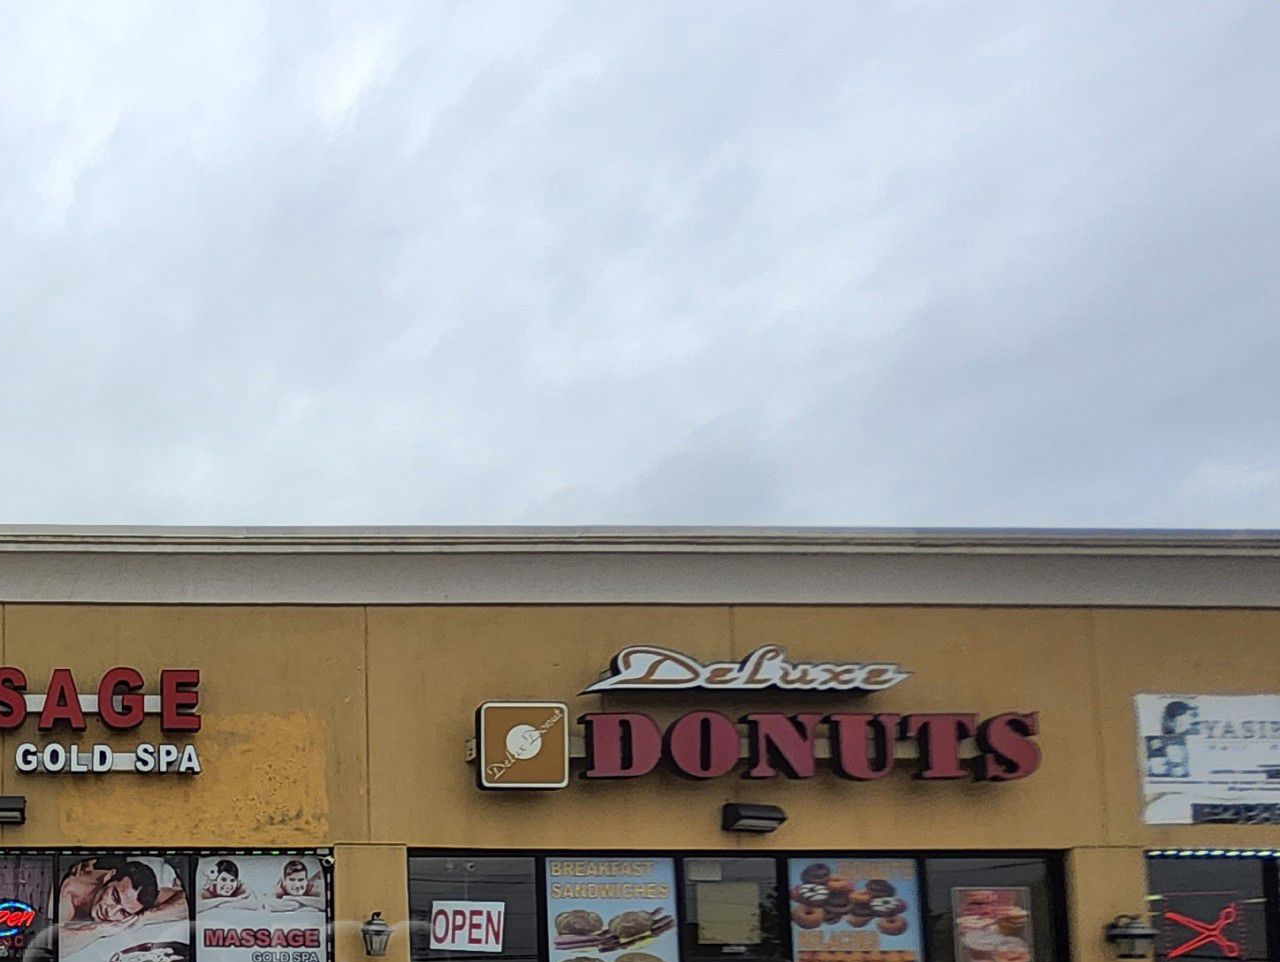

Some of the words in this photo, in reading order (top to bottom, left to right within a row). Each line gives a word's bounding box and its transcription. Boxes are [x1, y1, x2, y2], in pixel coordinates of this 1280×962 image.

[15, 743, 114, 773] GOLD
[134, 743, 202, 773] SPA
[580, 710, 1041, 782] DONUTS
[550, 861, 655, 877] BREAKFAST
[550, 882, 670, 899] SANDWICHES
[204, 928, 320, 948] MASSAGE
[432, 908, 502, 945] OPEN
